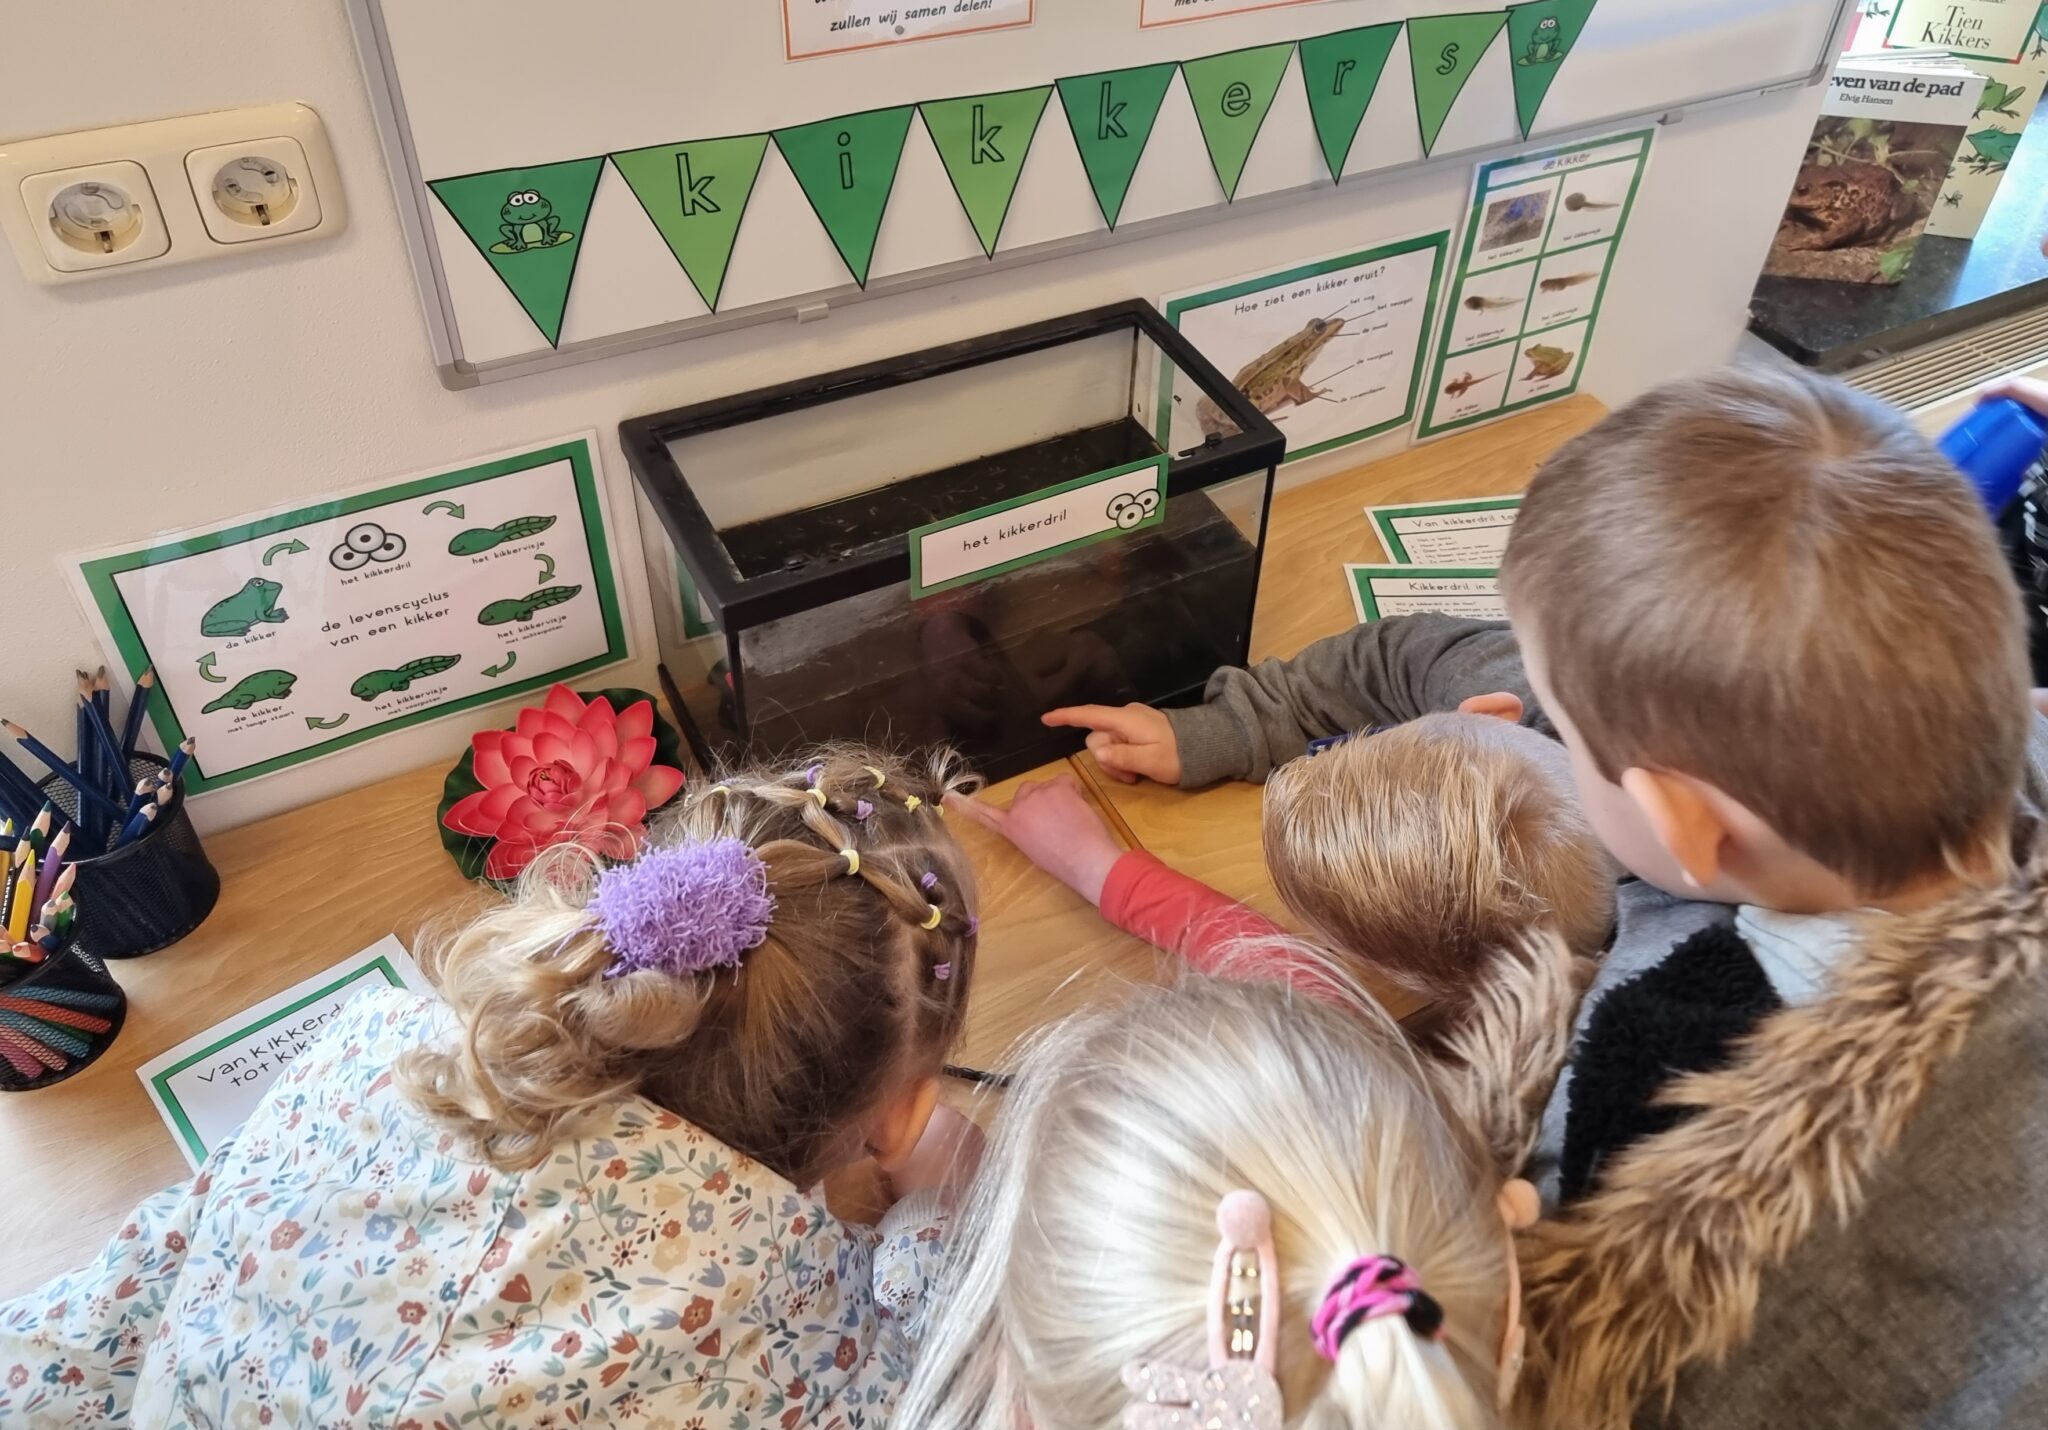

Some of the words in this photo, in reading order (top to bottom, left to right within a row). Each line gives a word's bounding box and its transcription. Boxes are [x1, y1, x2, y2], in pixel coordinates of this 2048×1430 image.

[830, 16, 871, 32] zullen
[879, 11, 898, 25] wij
[904, 5, 946, 20] samen
[953, 0, 993, 14] delen!
[1945, 5, 1984, 30] Tien
[1920, 21, 1991, 50] Kikkers
[1861, 95, 1894, 105] Hansen
[1869, 78, 1901, 92] van
[1903, 77, 1926, 94] de
[1925, 81, 1964, 98] pad
[1234, 302, 1258, 316] Hoe
[1264, 294, 1285, 308] ziet
[1291, 288, 1311, 300] een
[1316, 278, 1348, 294] kikker
[1353, 266, 1386, 283] eruit?
[963, 535, 990, 552] het
[999, 508, 1067, 541] kikkerdril
[1412, 519, 1438, 528] Van
[1443, 515, 1496, 526] kikkerdril
[472, 555, 489, 566] het
[493, 540, 546, 560] kikkervisje
[340, 575, 359, 587] het
[364, 561, 412, 580] kikkerdril
[1408, 582, 1470, 591] Kikkerdril
[1475, 582, 1486, 590] in
[321, 620, 341, 633] de
[350, 590, 450, 625] levenscyclus
[330, 633, 360, 647] van
[368, 622, 397, 637] een
[404, 607, 450, 627] kikker
[497, 628, 514, 640] het
[518, 614, 568, 632] kikkervisje
[225, 640, 240, 650] de
[245, 631, 277, 645] kikker
[374, 702, 392, 713] het
[396, 685, 448, 706] kikkervisje
[233, 713, 247, 724] de
[251, 704, 283, 719] kikker
[197, 1054, 248, 1083] Van
[249, 1003, 345, 1060] kikkerd
[229, 1061, 271, 1087] tot
[274, 1034, 316, 1065] kik
